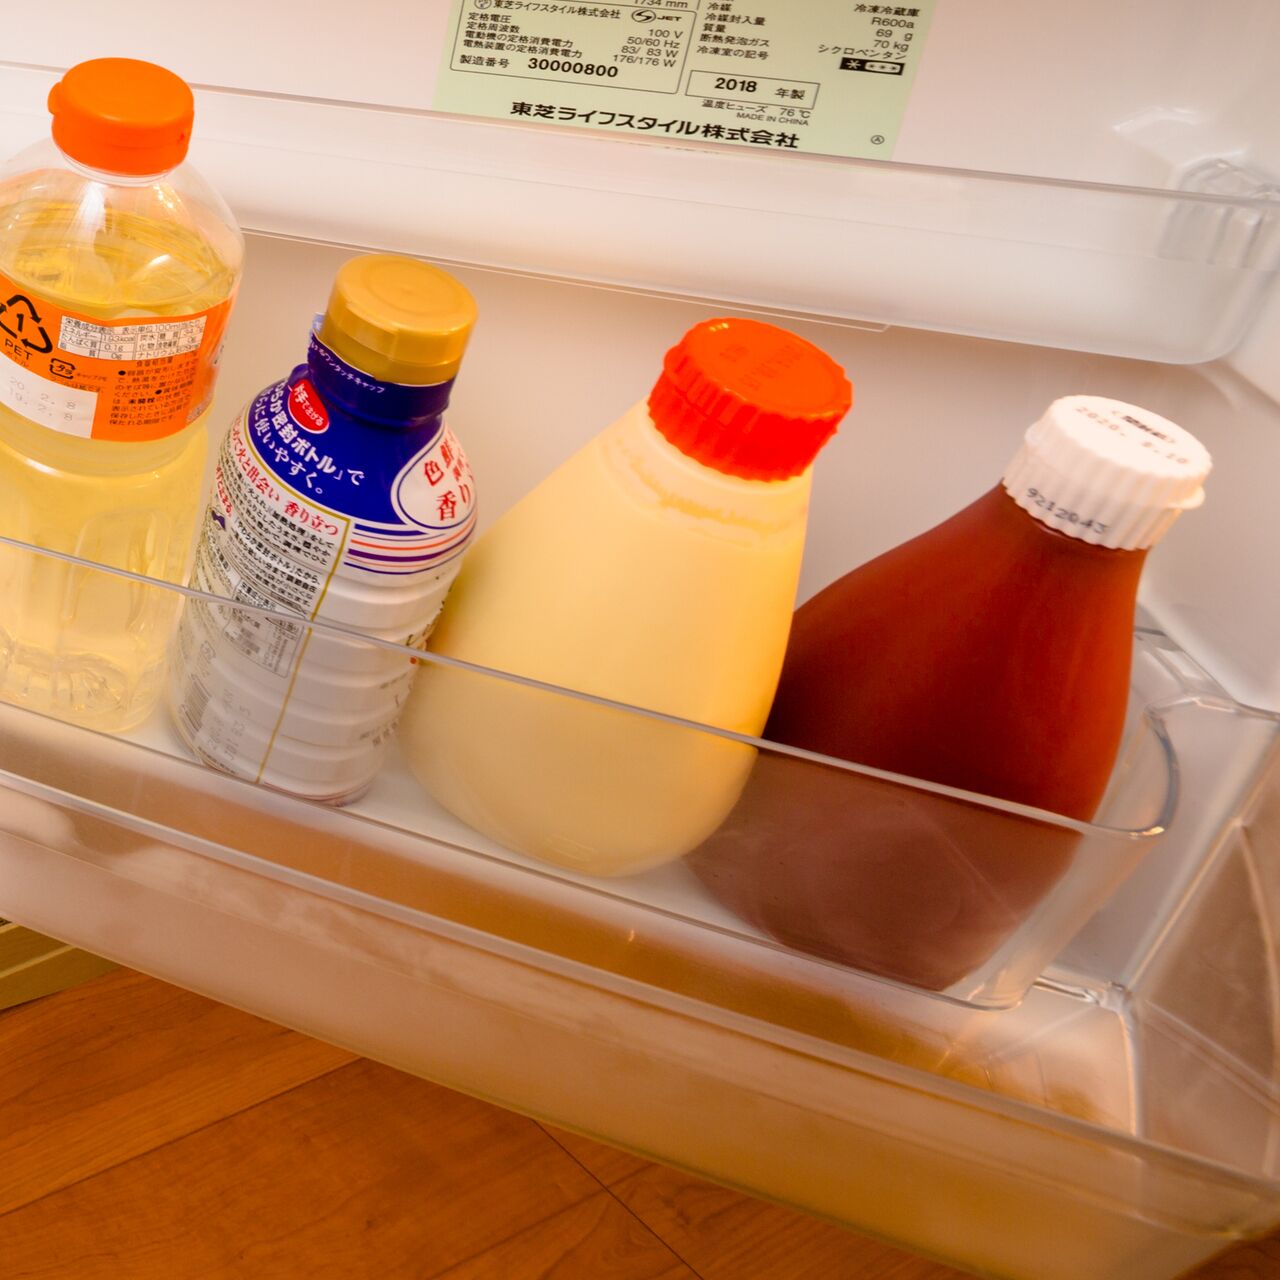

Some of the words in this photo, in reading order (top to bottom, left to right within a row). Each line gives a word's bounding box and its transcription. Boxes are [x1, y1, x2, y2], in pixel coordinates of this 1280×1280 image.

[665, 0, 688, 8] mm
[871, 17, 915, 29] R600a
[648, 29, 670, 38] 100
[674, 31, 683, 39] V
[875, 28, 893, 38] 69
[627, 36, 660, 47] 50/60
[664, 40, 680, 49] Hz
[873, 39, 890, 49] 70
[893, 41, 909, 53] kg
[459, 54, 510, 69] 製造番号
[528, 57, 618, 78] 30000800
[714, 77, 757, 93] 2018
[774, 87, 806, 100] 年製
[510, 101, 800, 149] 東芝ライフスタイル株式会社
[736, 111, 765, 121] MADE
[766, 114, 776, 123] IN
[778, 116, 809, 126] CHINA
[4, 338, 33, 361] PET
